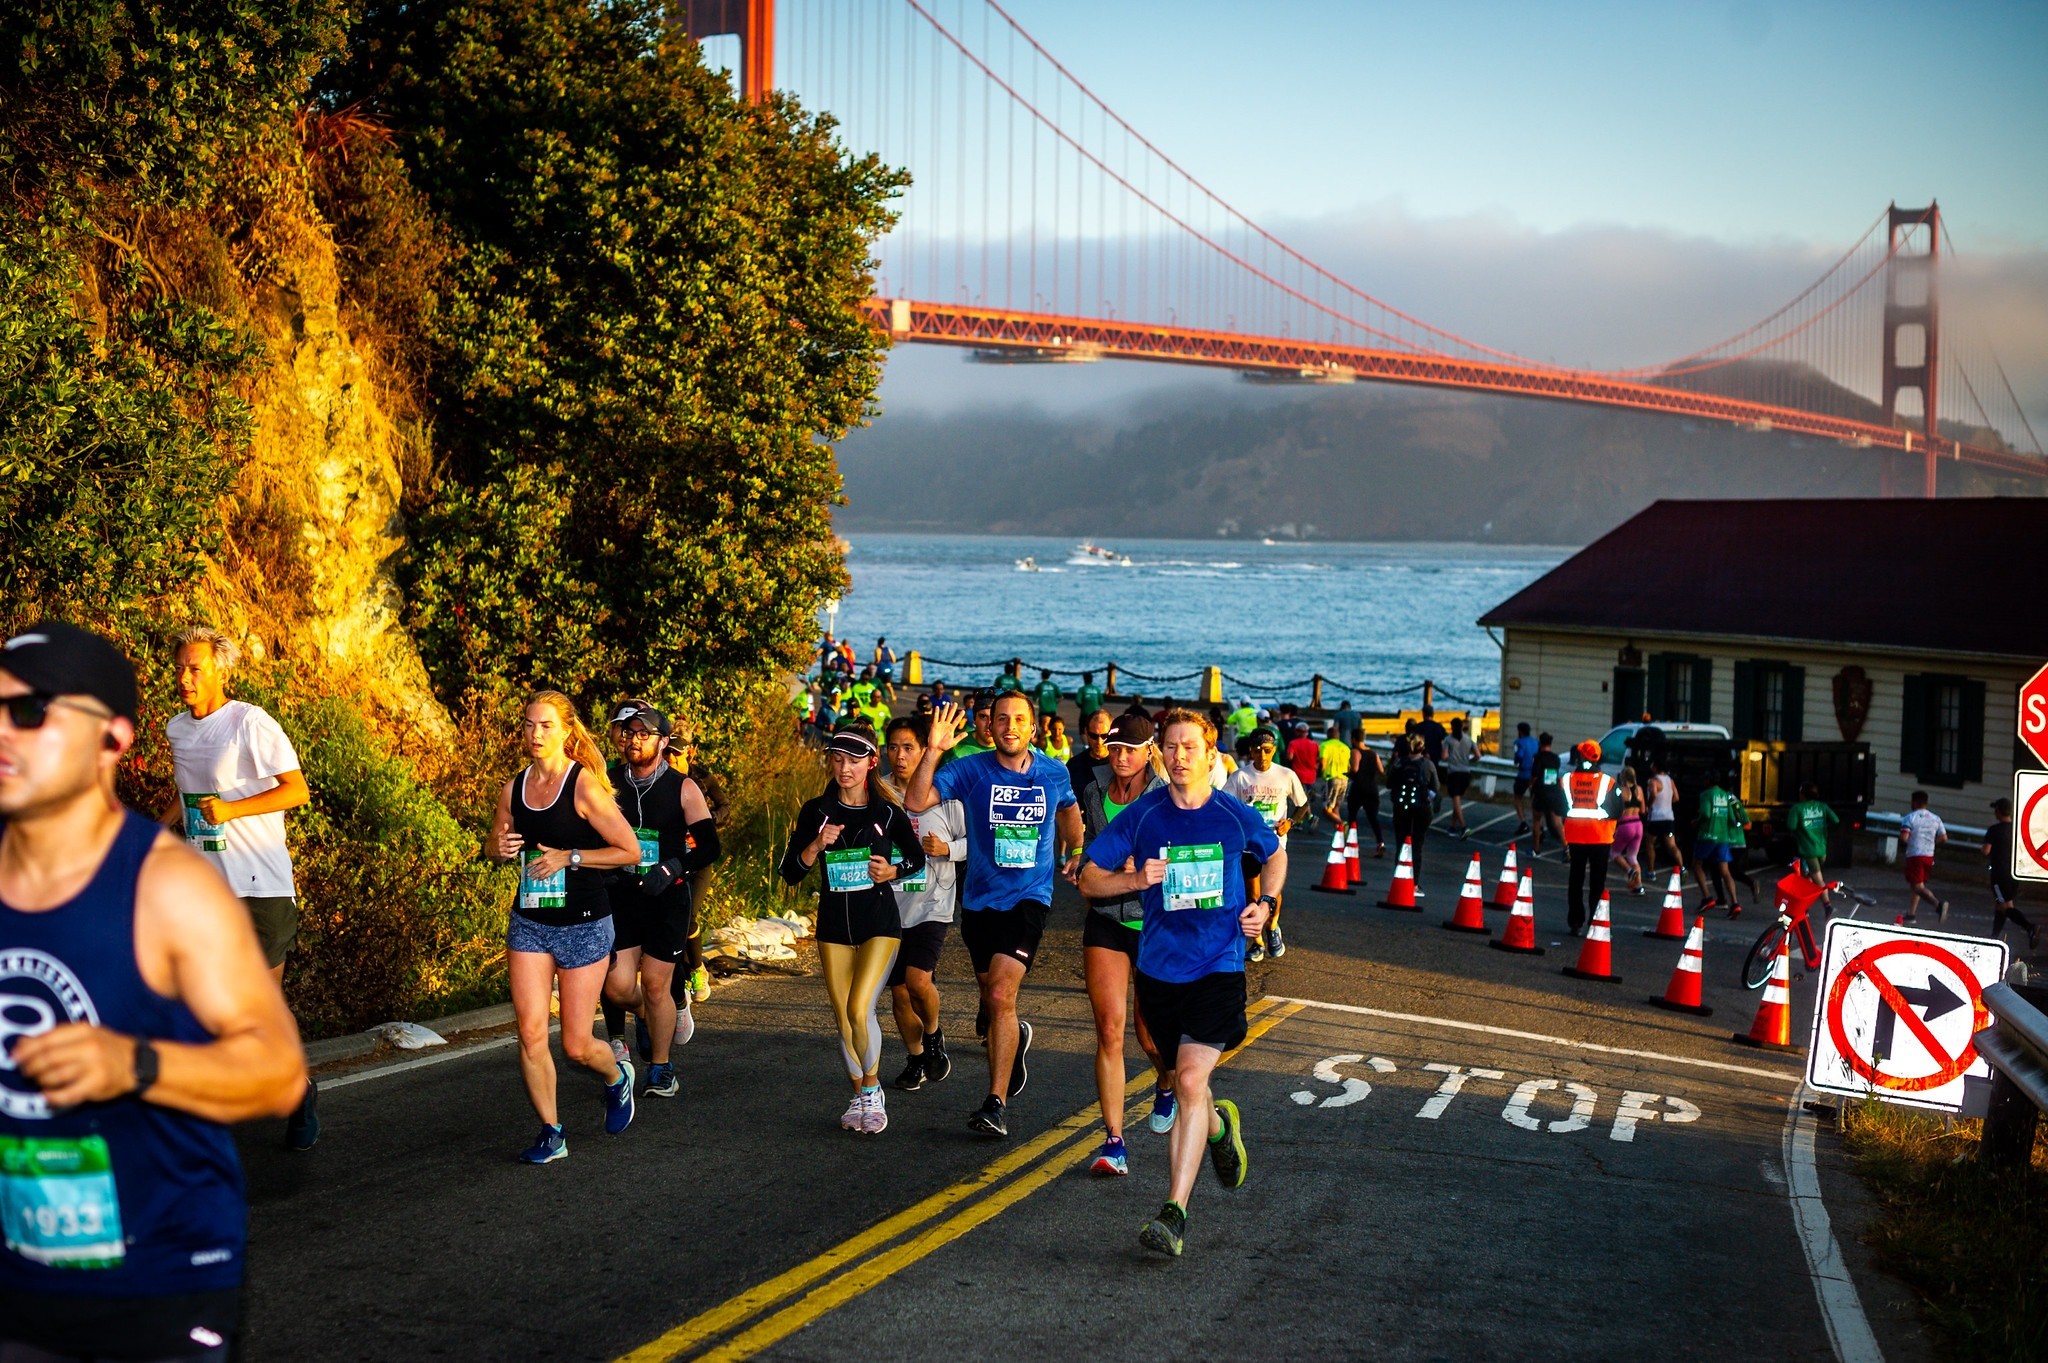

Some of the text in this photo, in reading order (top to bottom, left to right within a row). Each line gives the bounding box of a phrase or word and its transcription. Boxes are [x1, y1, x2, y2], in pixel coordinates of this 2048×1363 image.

[992, 810, 1004, 819] km
[1005, 847, 1034, 859] 5713
[840, 870, 869, 883] 4828
[1182, 872, 1218, 888] 6177
[1289, 1053, 1702, 1143] STOP
